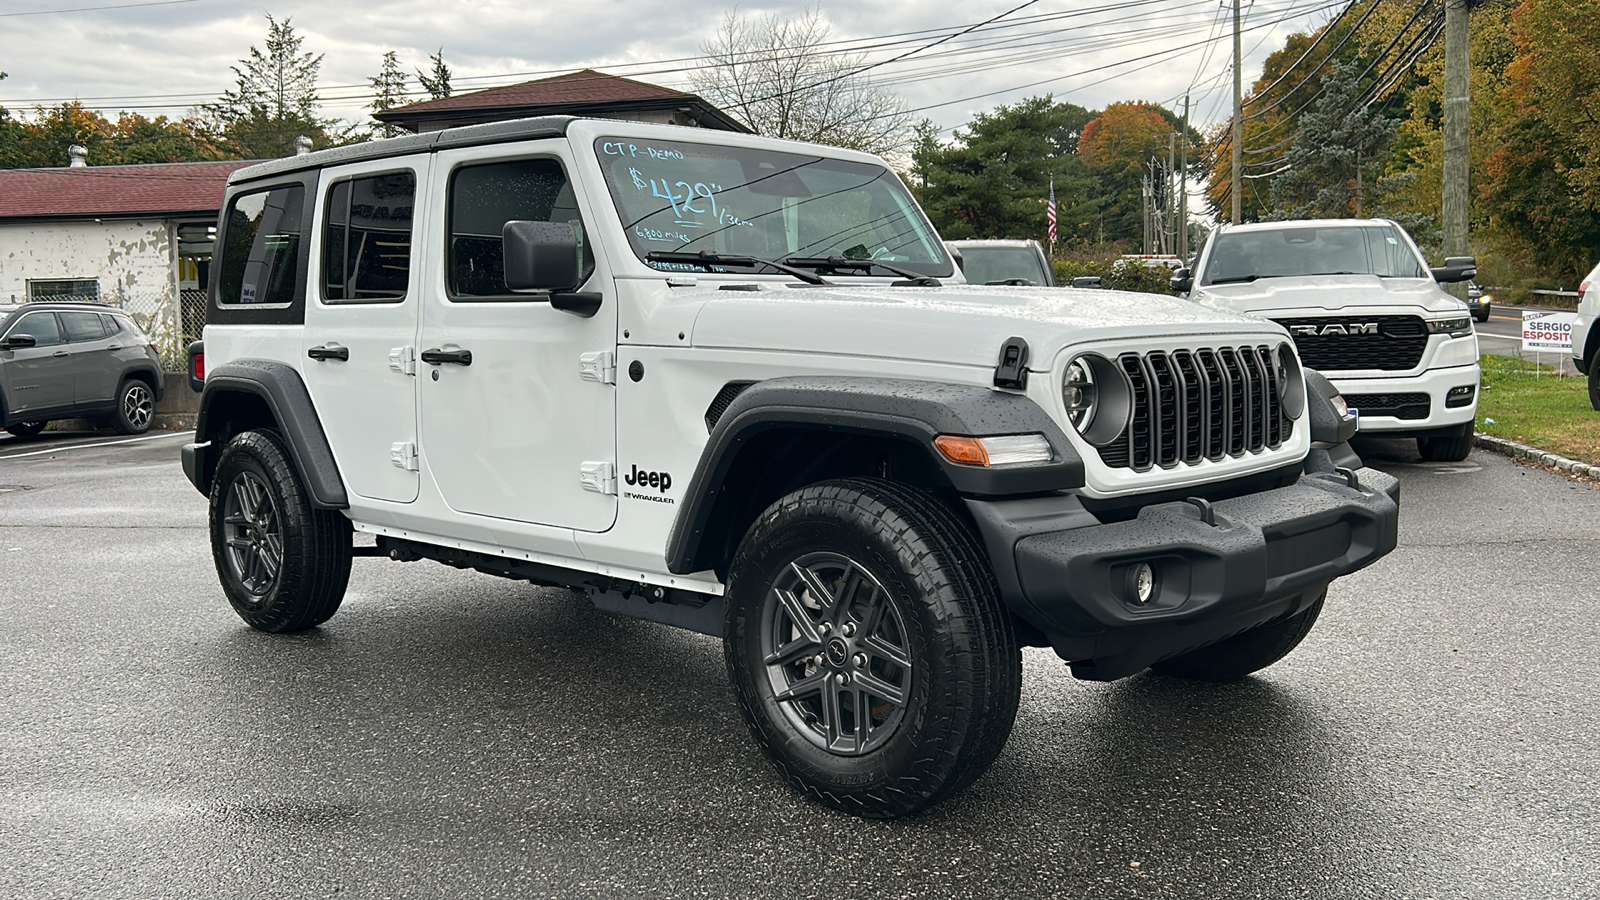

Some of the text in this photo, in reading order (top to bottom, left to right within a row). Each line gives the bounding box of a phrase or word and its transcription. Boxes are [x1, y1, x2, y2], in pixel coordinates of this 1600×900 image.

[1290, 323, 1378, 336] RAM
[1529, 321, 1571, 332] SERGIO
[1523, 330, 1573, 342] ESPOSIT
[624, 464, 672, 493] Jeep
[631, 493, 675, 505] WRANGLER
